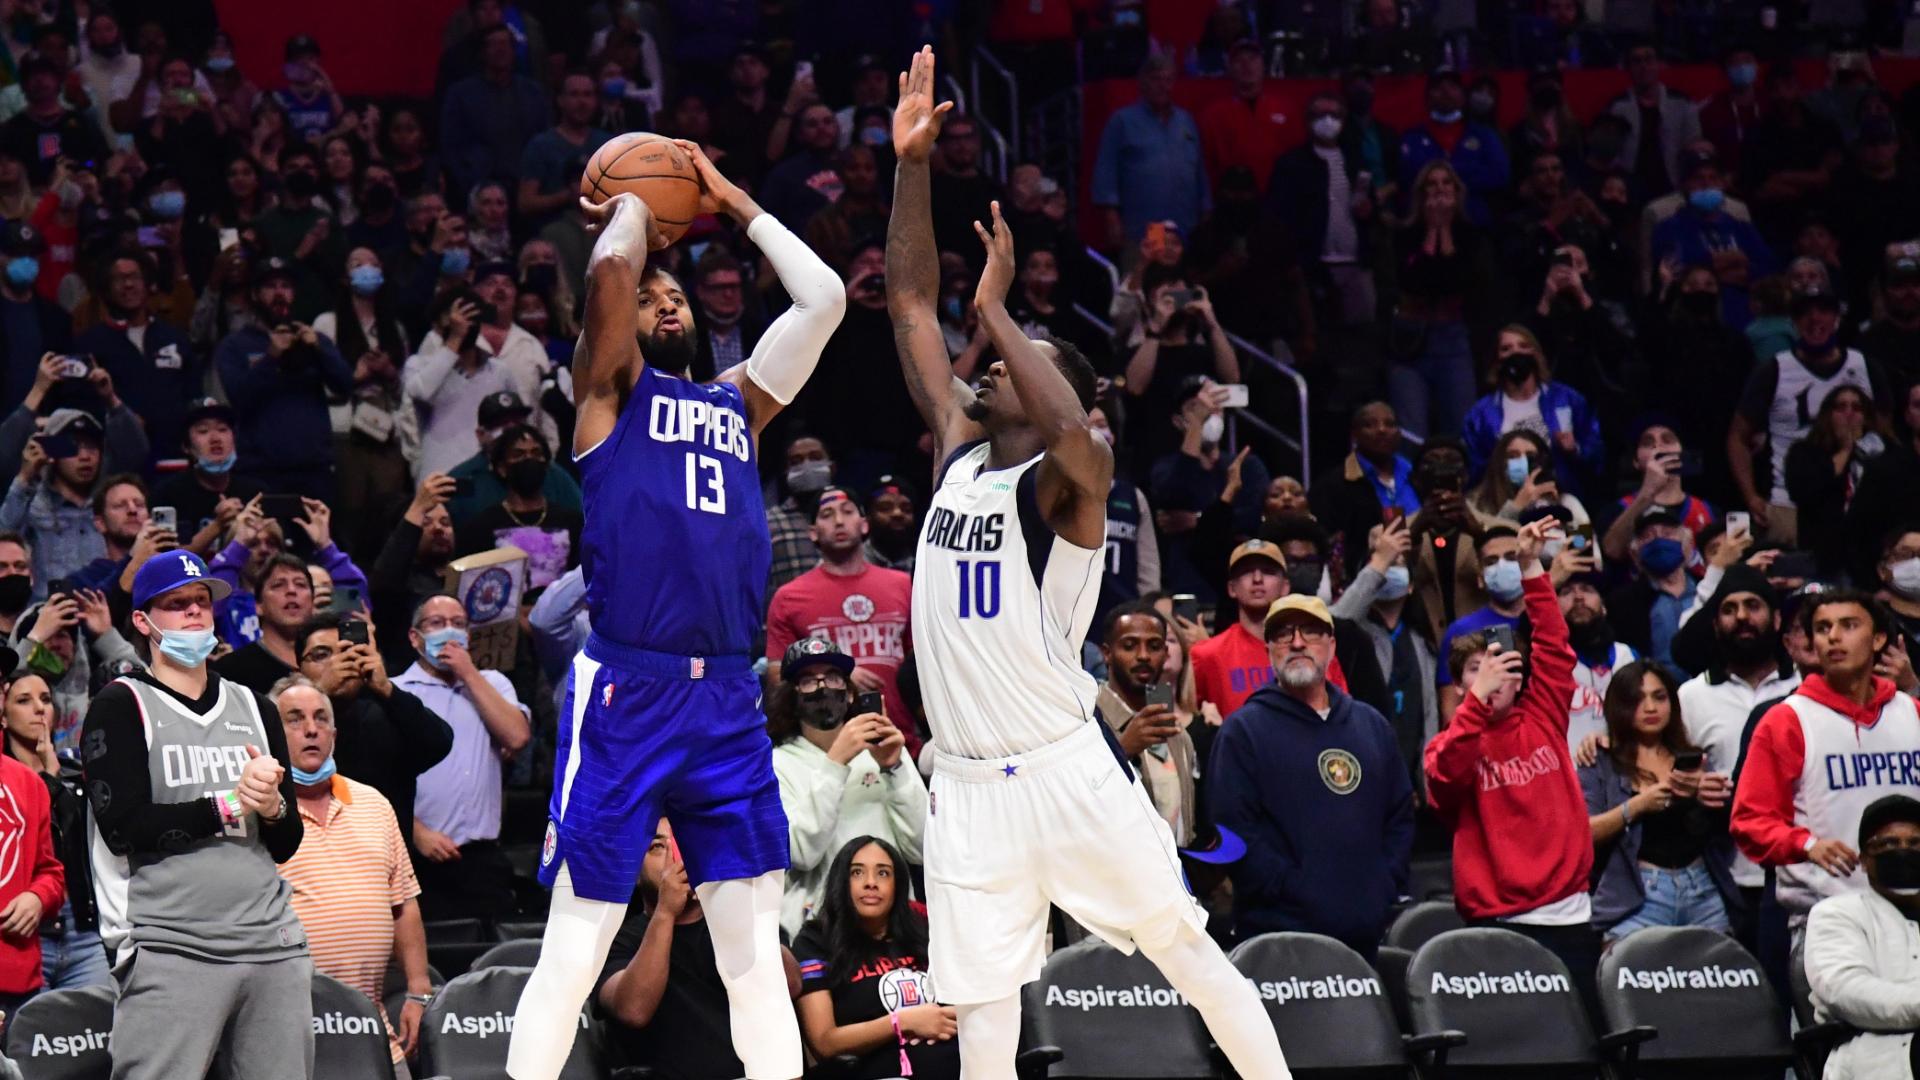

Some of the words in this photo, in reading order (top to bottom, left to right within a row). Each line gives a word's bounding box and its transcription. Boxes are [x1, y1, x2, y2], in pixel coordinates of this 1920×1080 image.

[648, 394, 749, 463] CLIPPERS
[685, 451, 726, 515] 13
[927, 506, 1005, 552] DALLAS
[178, 555, 202, 577] LA
[956, 560, 1001, 619] 10
[162, 744, 259, 788] CLIPPER
[1431, 970, 1570, 999] Aspiration
[1618, 965, 1759, 993] Aspiration
[313, 1011, 380, 1034] ation
[31, 1028, 113, 1058] Aspir
